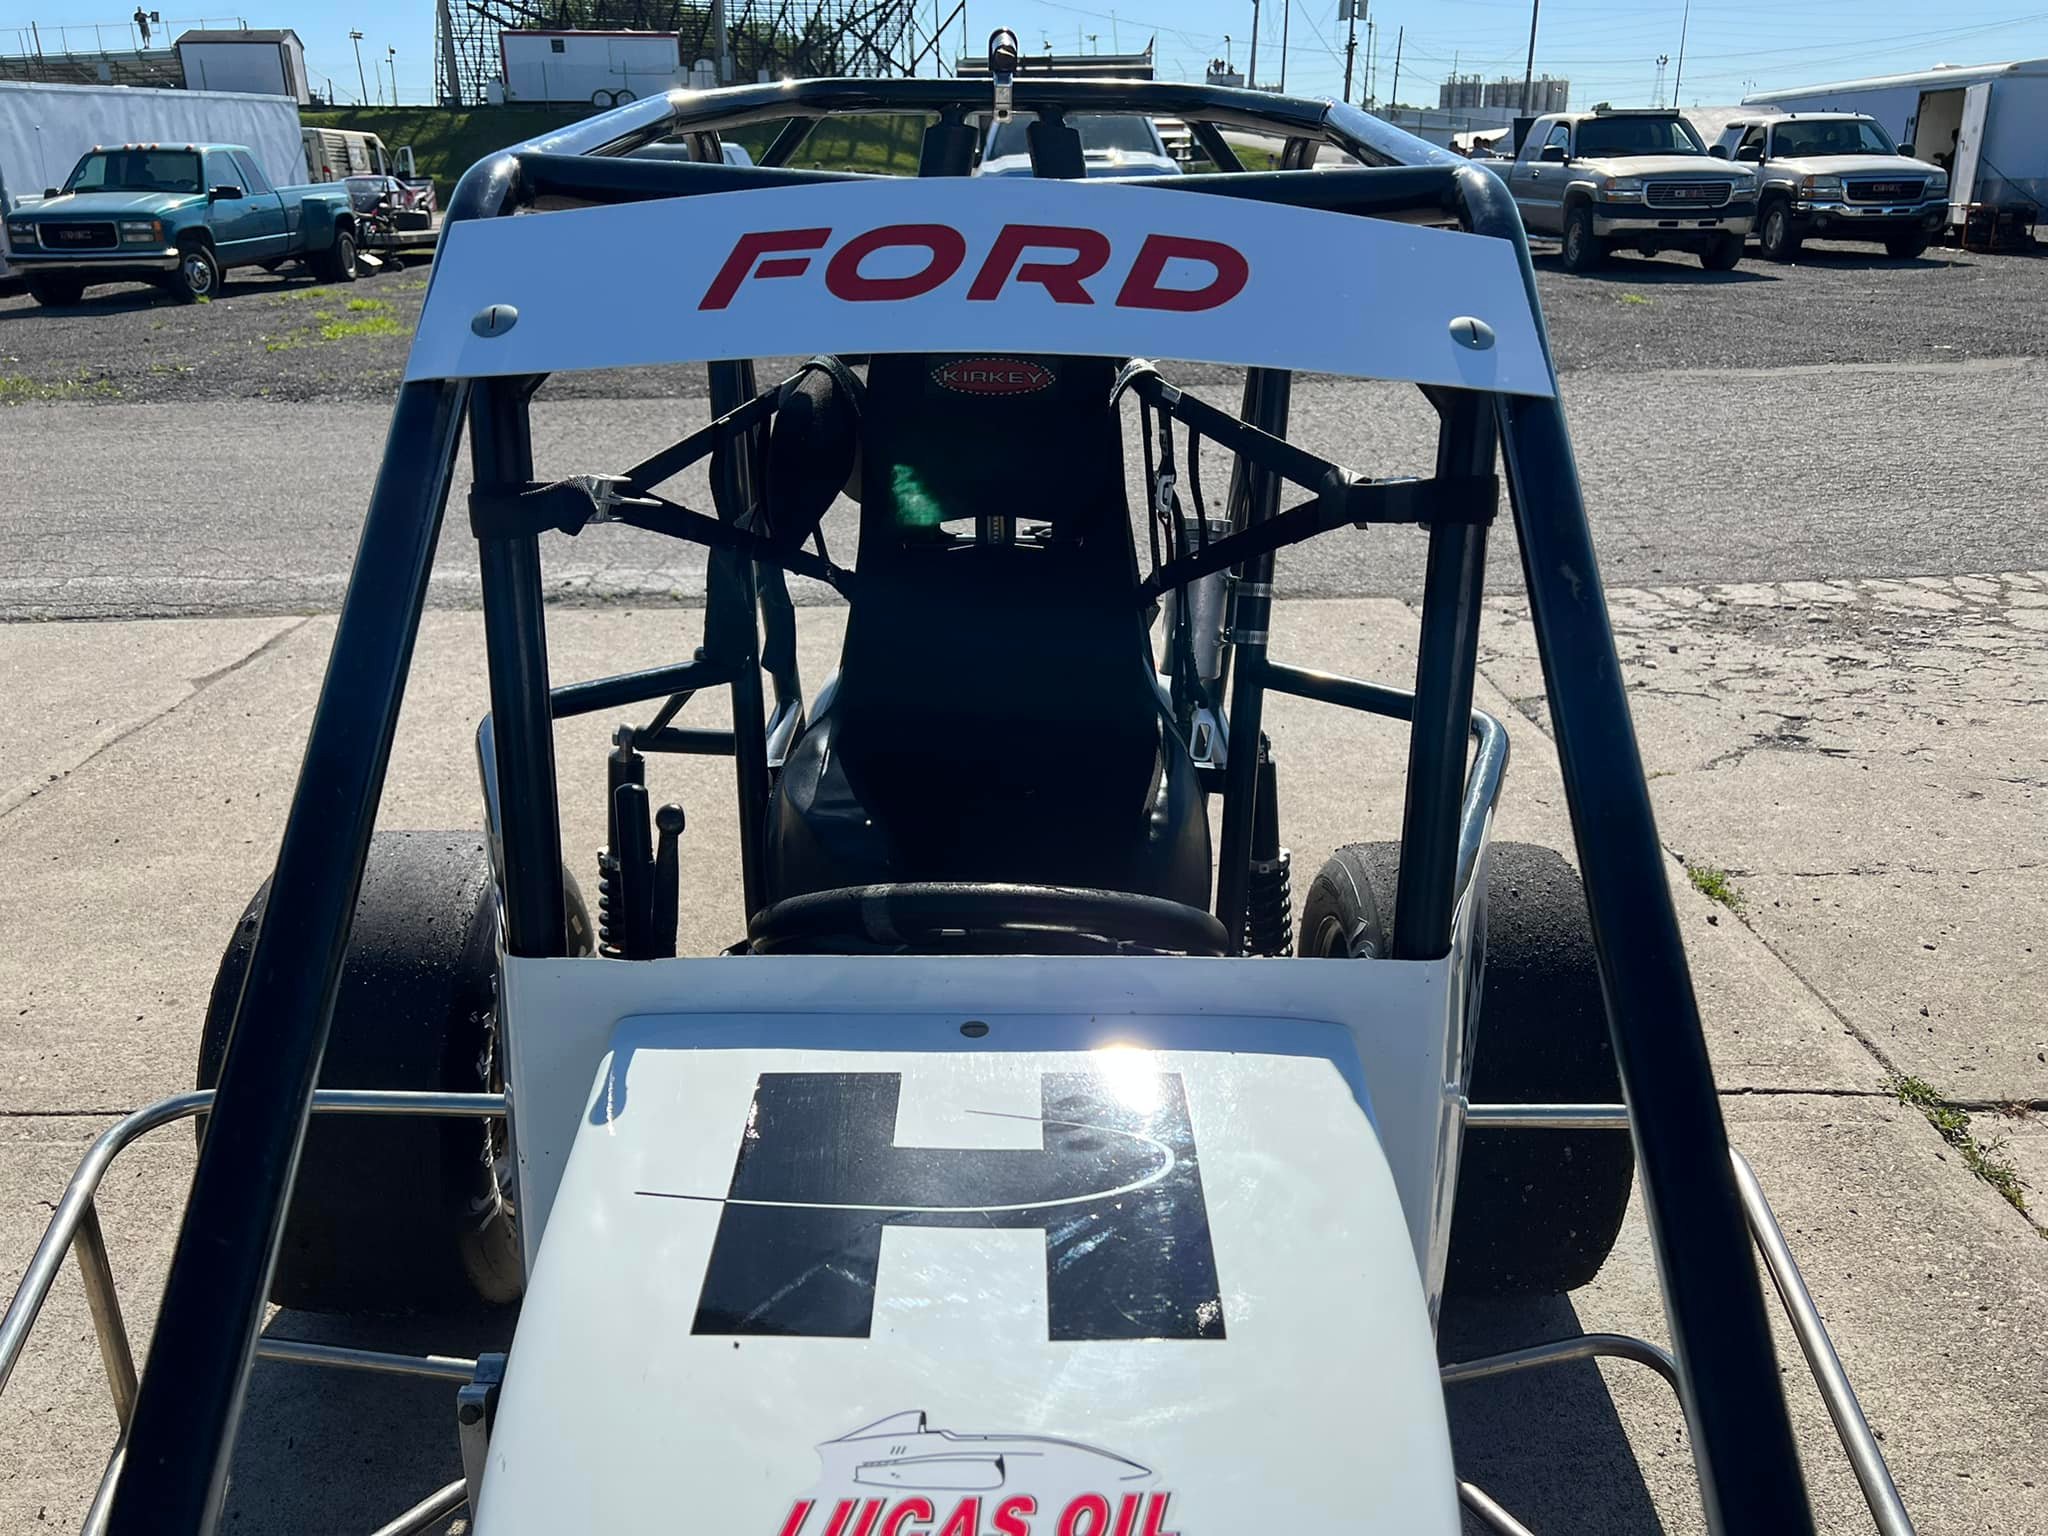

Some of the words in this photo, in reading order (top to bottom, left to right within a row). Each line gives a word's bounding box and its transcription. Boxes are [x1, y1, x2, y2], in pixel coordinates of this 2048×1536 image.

[696, 223, 1250, 313] FORD
[943, 370, 1042, 384] KIRKEY
[690, 1072, 1227, 1342] H
[775, 1494, 1038, 1536] LUCAS
[1056, 1491, 1182, 1536] OIL
